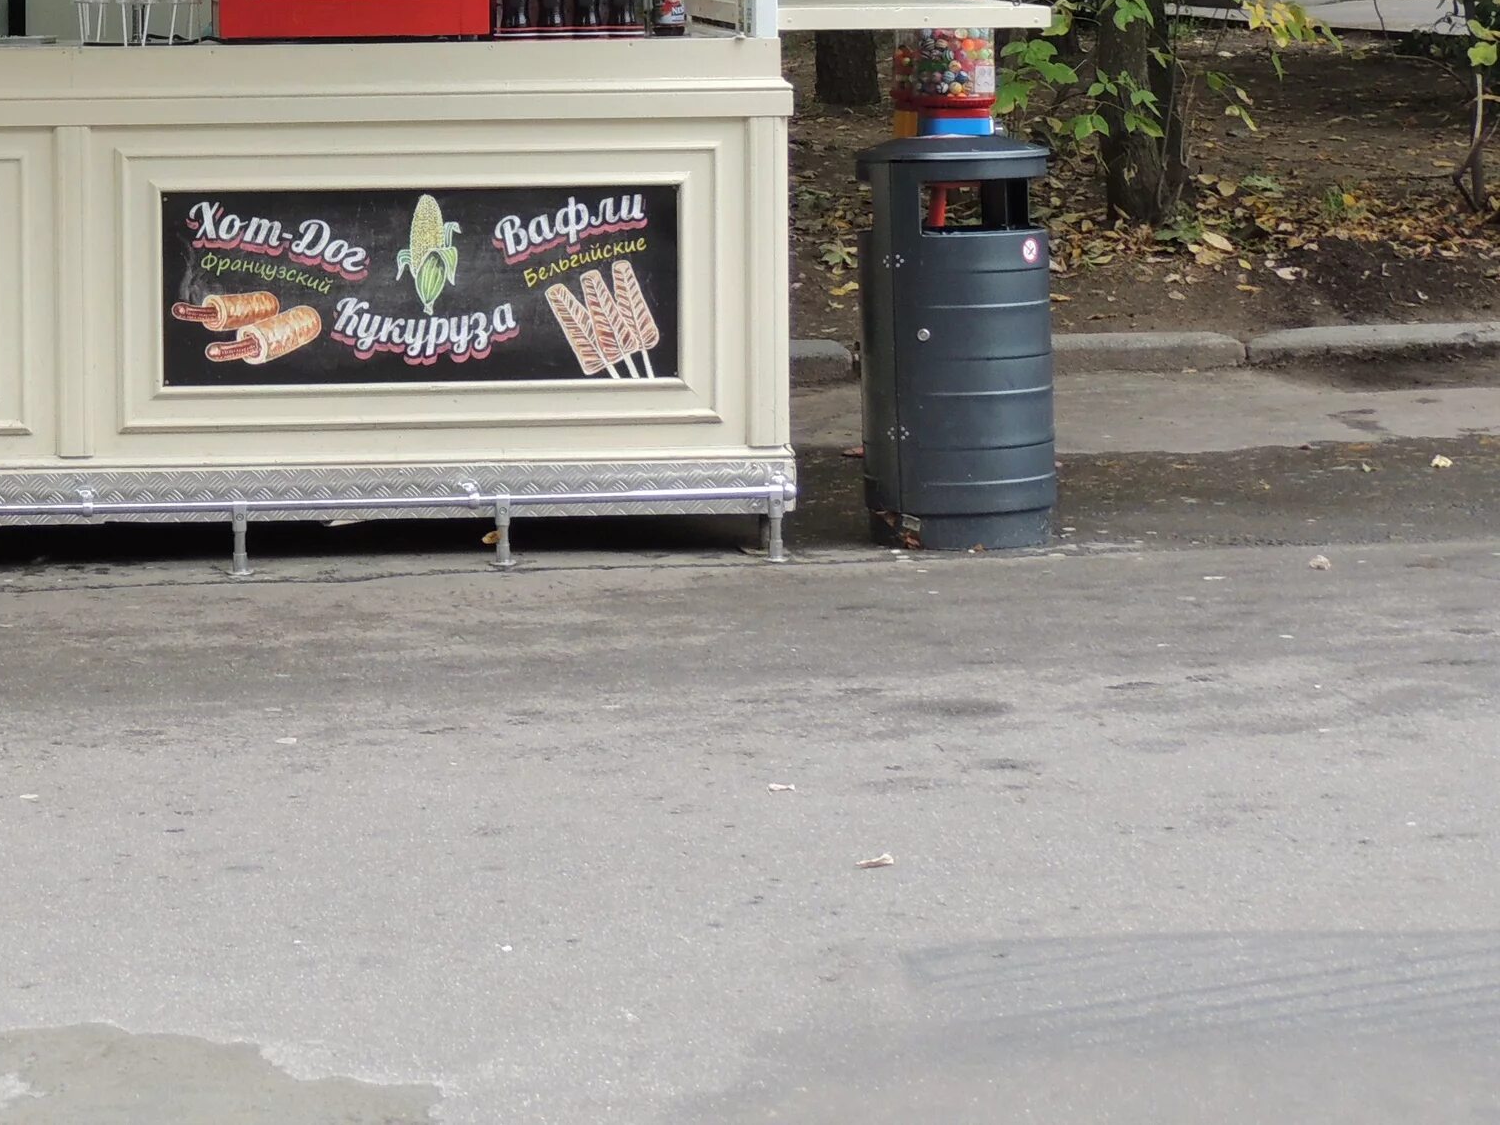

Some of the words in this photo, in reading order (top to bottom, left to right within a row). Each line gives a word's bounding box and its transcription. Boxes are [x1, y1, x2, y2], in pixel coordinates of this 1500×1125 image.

[190, 201, 368, 273] Хот-Дог
[496, 193, 646, 259] Вафли
[200, 254, 333, 294] Французский
[523, 237, 647, 287] Бельгийские
[334, 296, 517, 359] Кукуруза
